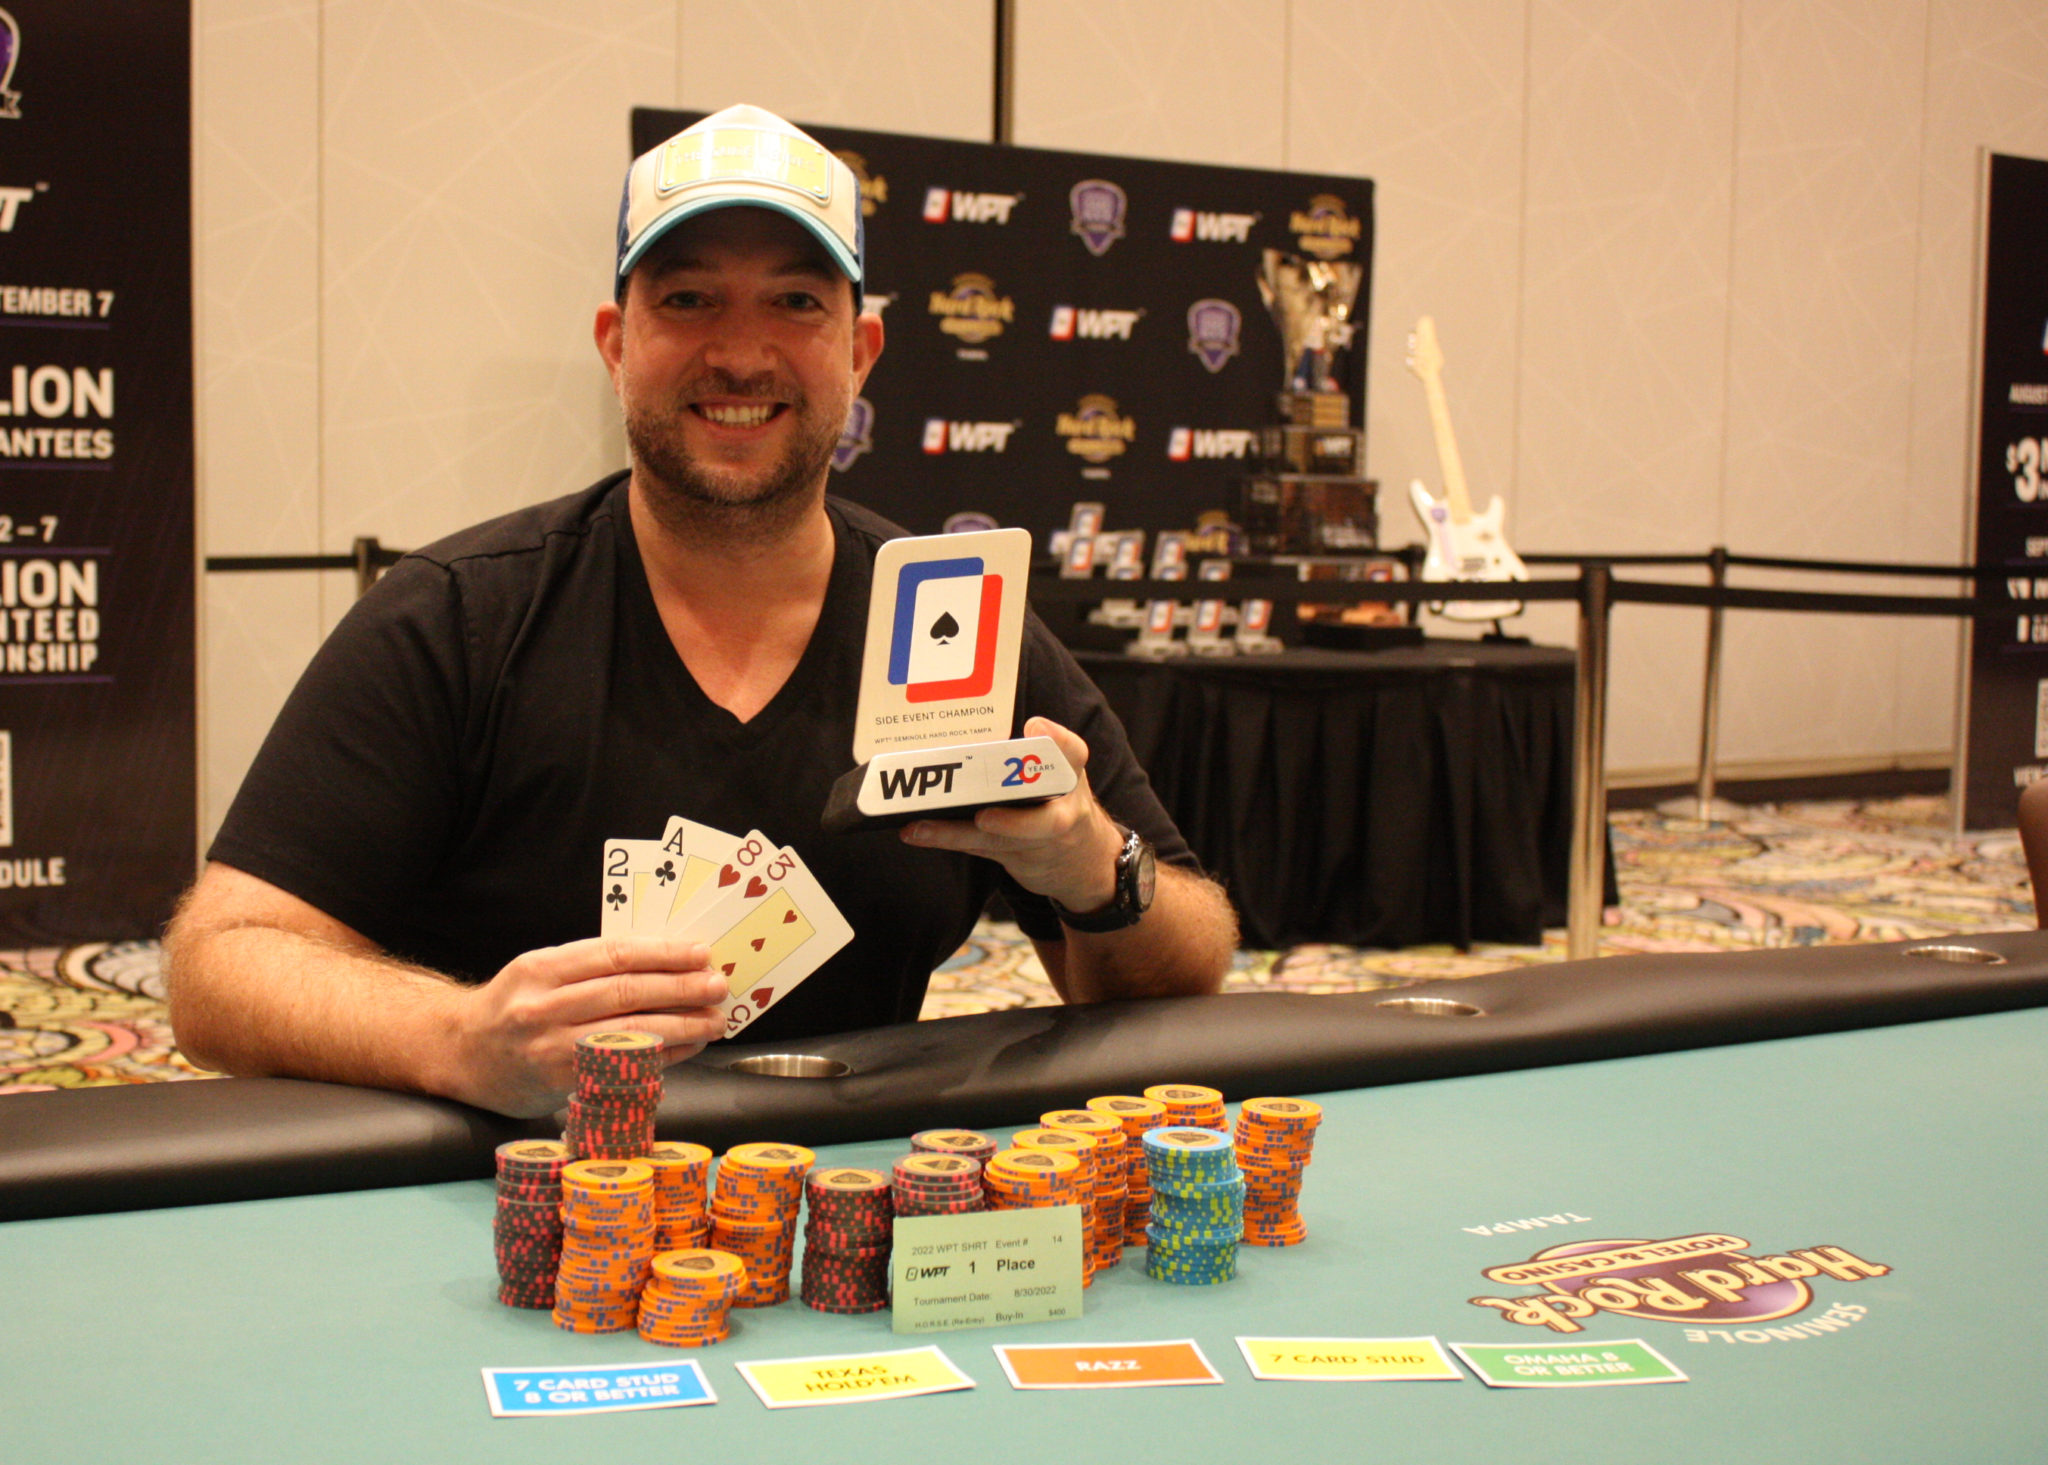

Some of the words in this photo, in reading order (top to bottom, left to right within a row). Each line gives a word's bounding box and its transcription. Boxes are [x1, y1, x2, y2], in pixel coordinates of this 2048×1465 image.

[951, 190, 1017, 225] WPT
[1195, 211, 1257, 244] WPT
[96, 289, 115, 318] 7
[1076, 308, 1139, 341] WPT
[949, 420, 1016, 453] WPT
[0, 559, 99, 608] ION
[0, 641, 98, 673] NSHIP
[875, 715, 900, 726] SIDE
[902, 711, 935, 723] EVENT
[938, 706, 995, 720] CHAMPION
[894, 733, 928, 743] SEMINOLE
[929, 730, 948, 739] HARD
[949, 729, 968, 738] ROCK
[970, 726, 993, 735] TAMPA
[1027, 763, 1056, 774] YEARS
[880, 762, 963, 800] WPT
[662, 826, 685, 857] A
[736, 839, 763, 867] 8
[606, 847, 630, 877] 2
[766, 852, 797, 882] 3
[1461, 1212, 1593, 1237] TAMPA
[911, 1246, 935, 1257] 2022
[936, 1244, 960, 1255] WPT
[961, 1241, 988, 1253] SHRT
[995, 1239, 1021, 1250] Event
[1052, 1235, 1063, 1246] 14
[1645, 1236, 1738, 1260] HOTEL
[920, 1265, 951, 1279] WPT
[968, 1260, 976, 1275] 1
[996, 1258, 1036, 1273] Place
[1501, 1257, 1617, 1281] CASINO
[1677, 1244, 1893, 1303] Hard
[914, 1295, 967, 1306] Tournament
[1014, 1285, 1058, 1298] 8/30/2022
[1467, 1275, 1710, 1335] Rock
[995, 1311, 1024, 1323] Buy-In
[1683, 1301, 1868, 1344] SEMINOLE
[1075, 1359, 1141, 1373] RAZZ
[1269, 1353, 1284, 1364] 7
[1293, 1353, 1358, 1365] CARD
[1364, 1353, 1425, 1365] STUD
[1503, 1353, 1600, 1366] OMAHA
[1513, 1365, 1553, 1377] OR
[1553, 1361, 1636, 1377] BETTER
[513, 1379, 531, 1392] 7
[538, 1377, 609, 1391] CARD
[615, 1373, 680, 1388] STUD
[804, 1373, 918, 1393] HOLD'EM
[811, 1364, 889, 1380] TEXAS
[524, 1391, 542, 1404] 8
[548, 1390, 588, 1403] OR
[594, 1384, 680, 1402] BETTER
